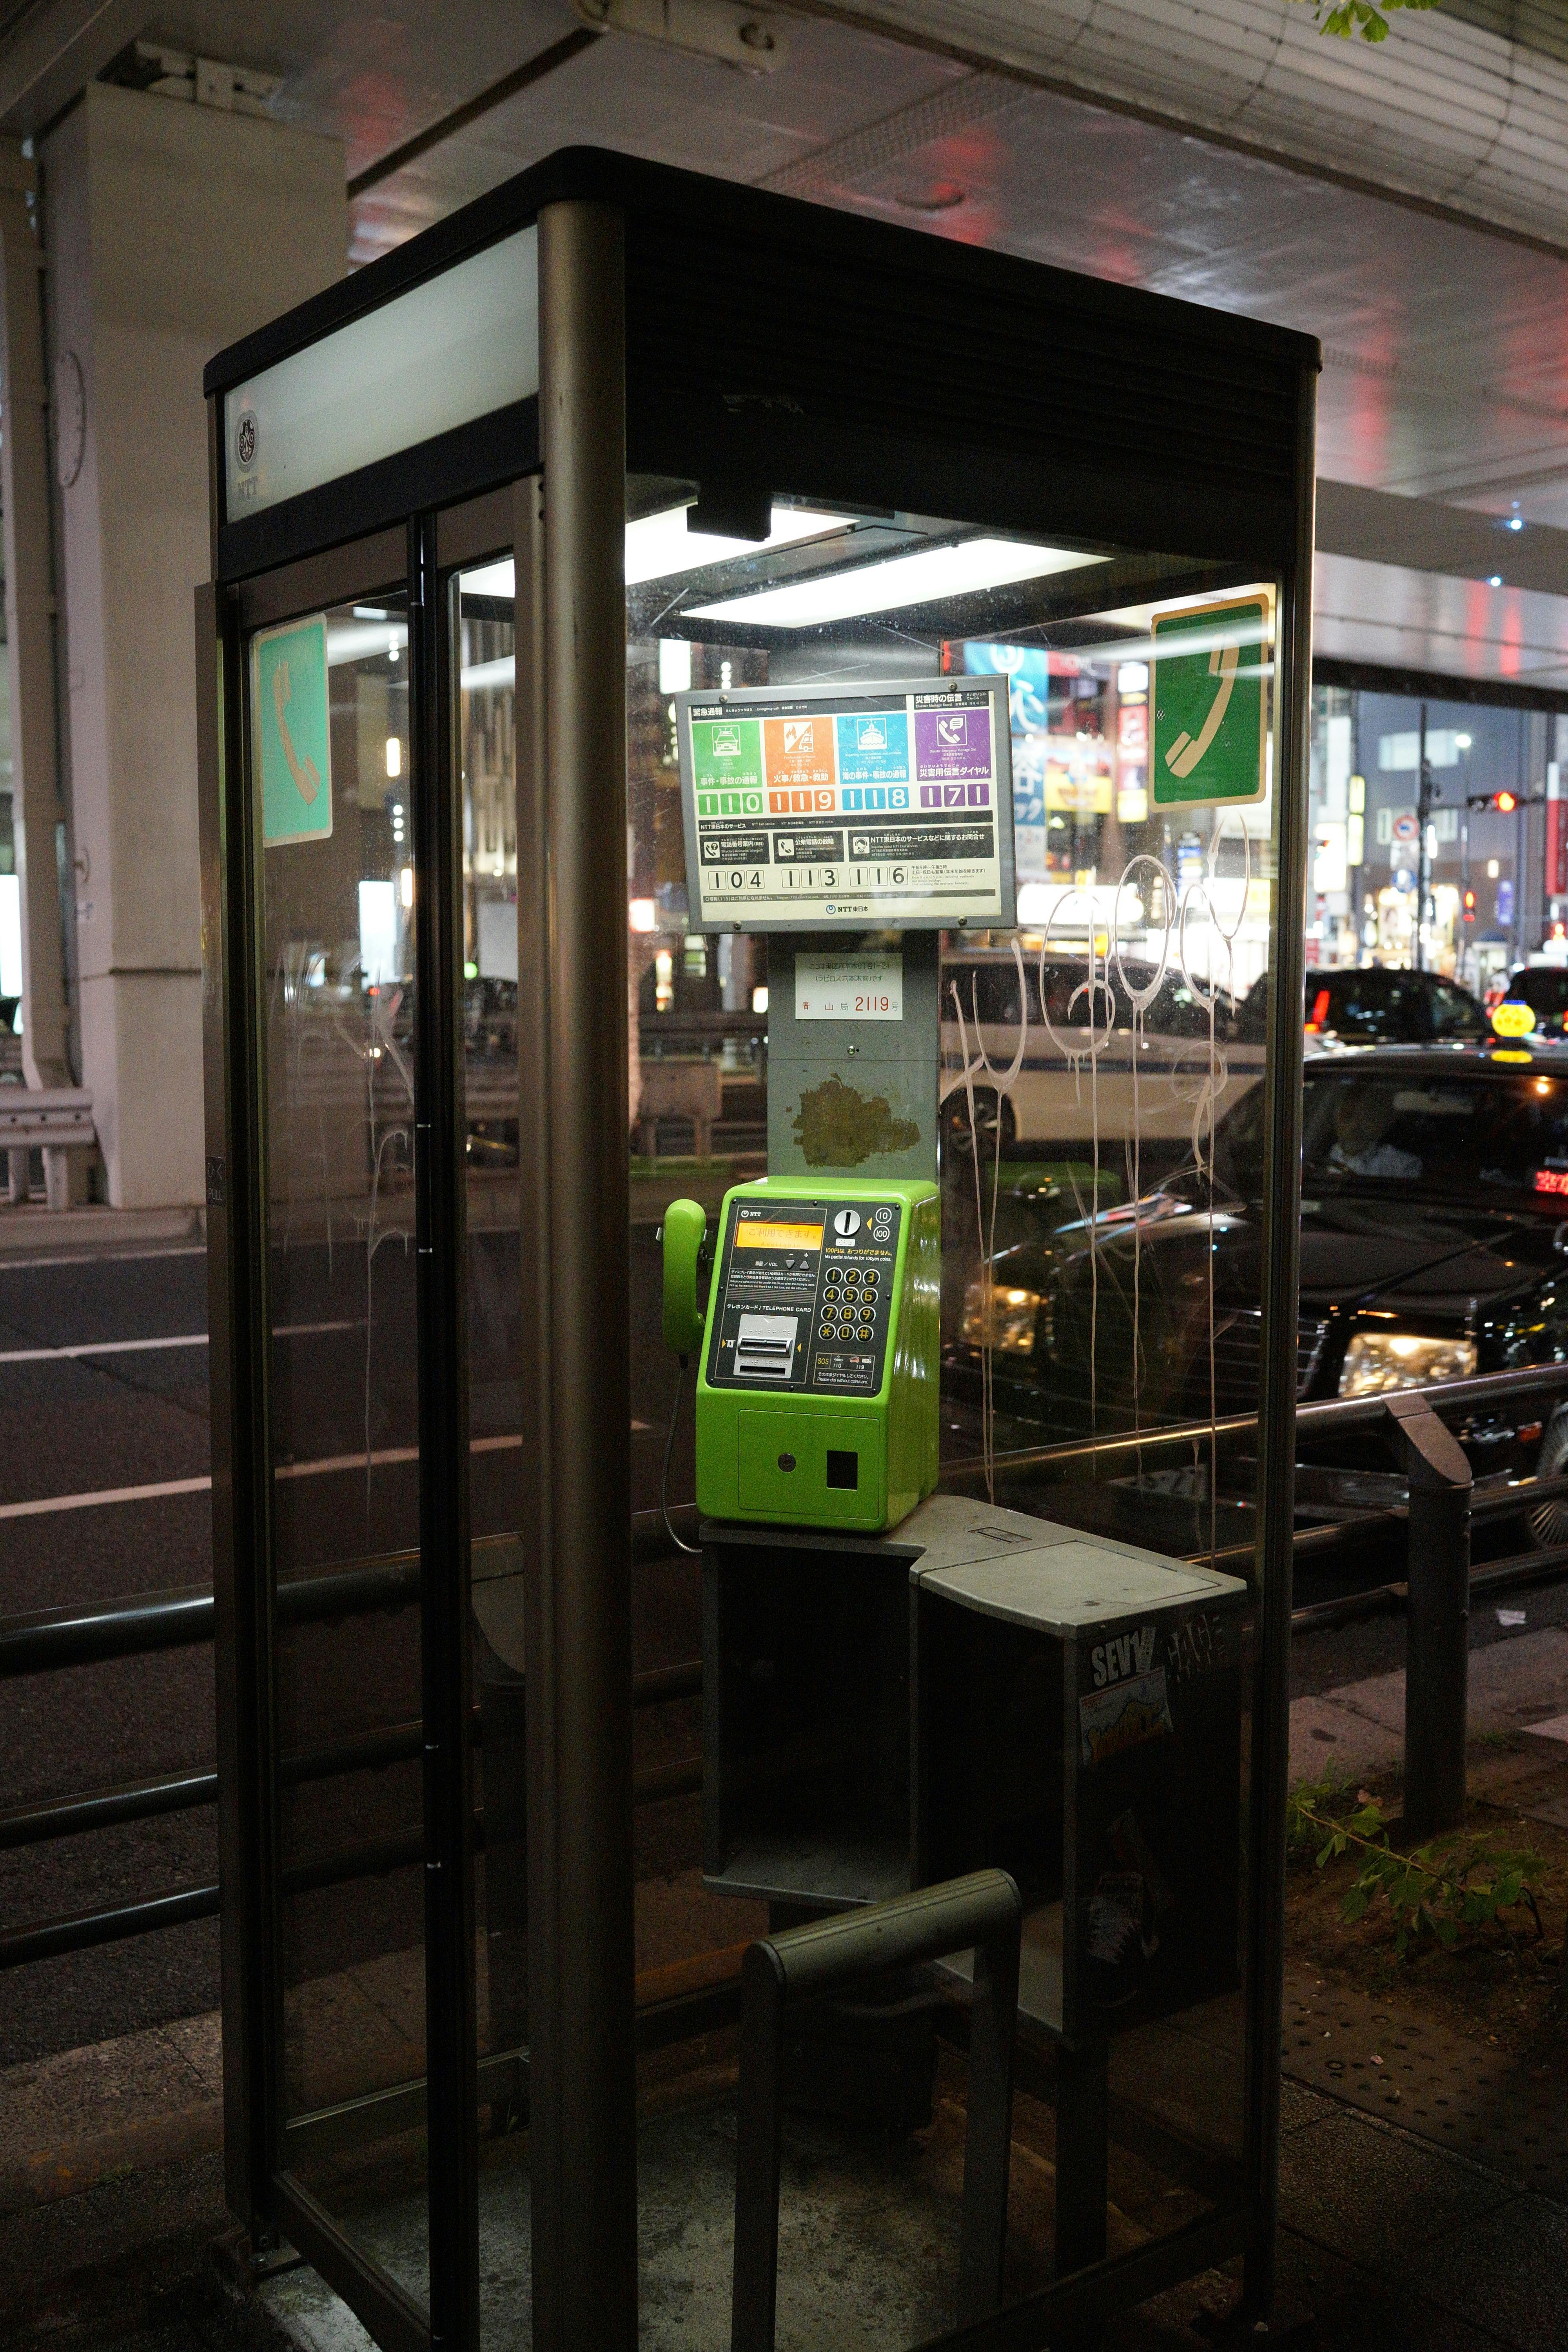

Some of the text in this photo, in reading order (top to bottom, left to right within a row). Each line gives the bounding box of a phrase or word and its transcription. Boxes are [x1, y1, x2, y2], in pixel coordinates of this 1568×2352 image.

[916, 693, 962, 704] 災害時の伝言
[693, 707, 722, 716] 緊急通報
[842, 769, 906, 780] 海の事件・事故の通報
[920, 766, 989, 777] 災害用伝言ダイヤル
[700, 775, 757, 786] 事件・事故の通報
[773, 773, 828, 783] 火事/救急・救助
[777, 791, 832, 810] 119
[850, 789, 906, 808] 118
[929, 786, 980, 805] 171
[706, 794, 760, 813] 110
[871, 834, 984, 843] NTT東日本のサービスなどに関するお問合せ
[716, 871, 761, 888] 104
[789, 869, 835, 887] 113
[857, 867, 904, 884] 116
[207, 1163, 222, 1180] ひく
[208, 1188, 223, 1201] PULL
[749, 1227, 816, 1239] ご利用できます。
[832, 1270, 874, 1282] 1 2 3
[827, 1289, 872, 1301] 4 5 6
[826, 1308, 870, 1320] 7 8 9
[842, 1327, 849, 1338] 0
